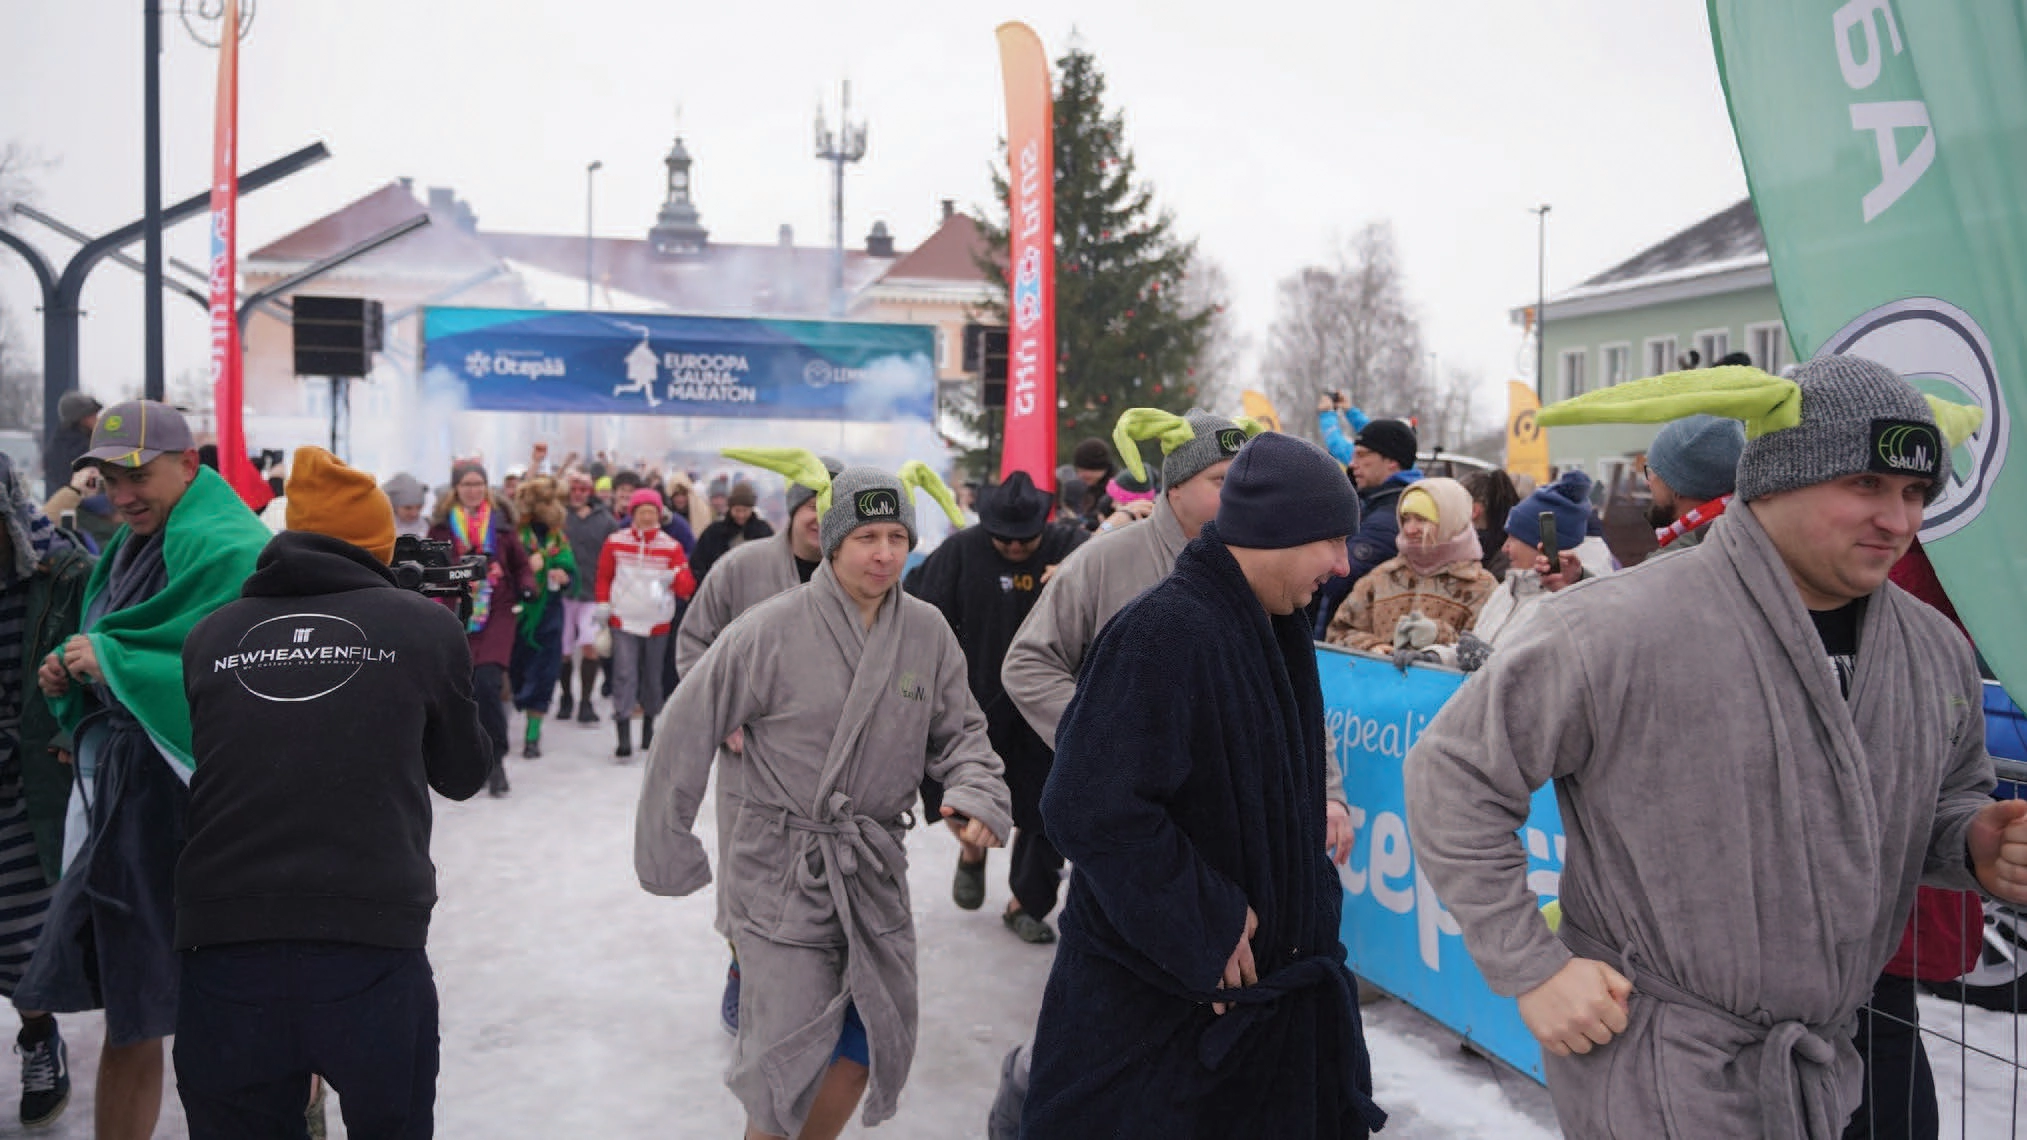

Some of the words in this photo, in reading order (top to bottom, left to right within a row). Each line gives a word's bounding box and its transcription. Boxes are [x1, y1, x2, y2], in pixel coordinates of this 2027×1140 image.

[494, 355, 567, 380] Otepää
[664, 352, 749, 371] EUROOPA
[667, 383, 757, 402] MARATON
[1889, 444, 1934, 472] SAUNA
[213, 646, 396, 673] NEWHEAVENFILM
